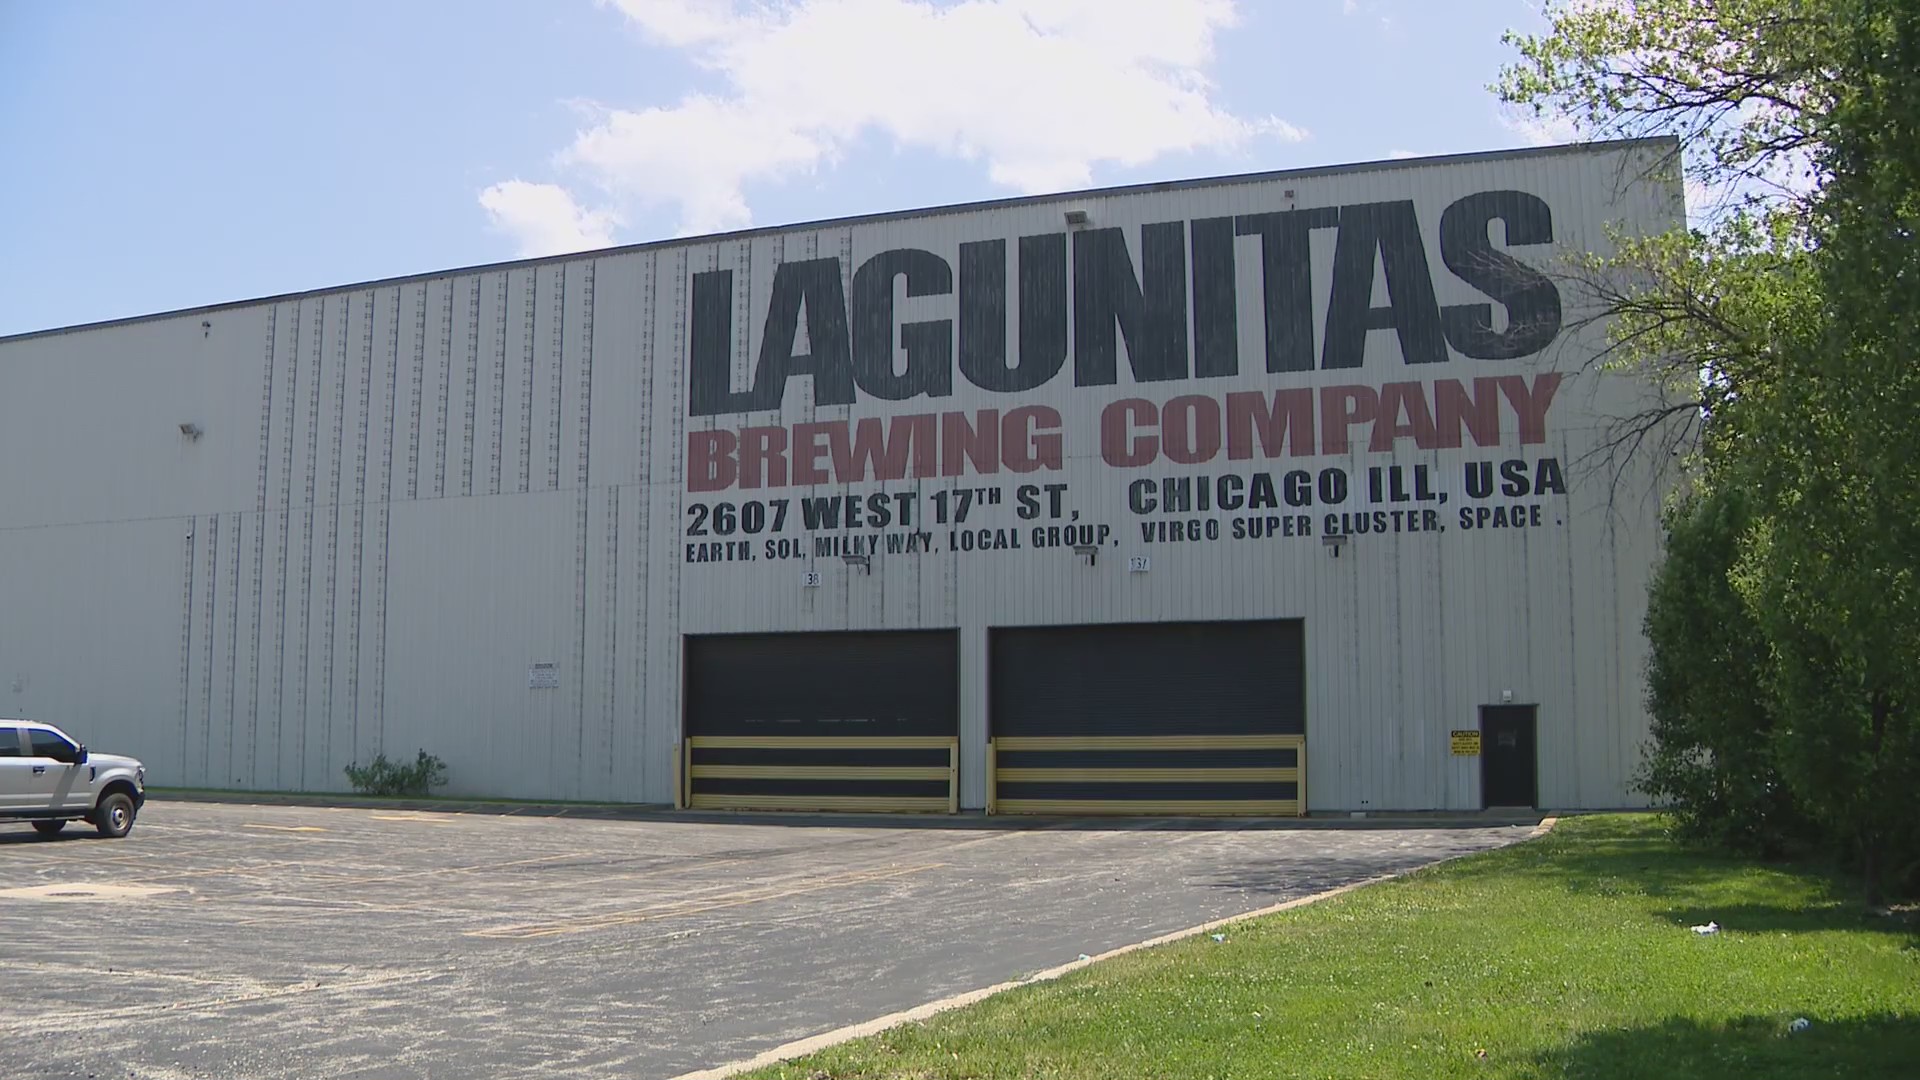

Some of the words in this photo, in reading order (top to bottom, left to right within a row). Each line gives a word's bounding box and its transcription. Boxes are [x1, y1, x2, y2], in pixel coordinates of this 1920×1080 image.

[690, 189, 1562, 418] LAGUNITAS
[688, 405, 1063, 493] BREWING
[1101, 372, 1563, 468] COMPANY
[686, 541, 756, 563] EARTH,
[765, 538, 806, 560] SOL,
[816, 534, 879, 558] MILKY
[887, 531, 938, 555] WAY,
[950, 528, 1021, 552] LOCAL
[1032, 524, 1119, 548] GROUP,
[1142, 519, 1219, 543] VIRGO
[1232, 515, 1312, 540] SUPER
[1324, 509, 1446, 535] CLUSTER,
[687, 502, 789, 536] 2607
[801, 492, 916, 530] WEST
[930, 487, 1001, 524] 17TH
[1017, 484, 1079, 521] ST,
[1129, 470, 1347, 515] CHICAGO
[1369, 464, 1448, 505] ILL,
[1465, 458, 1566, 499] USA
